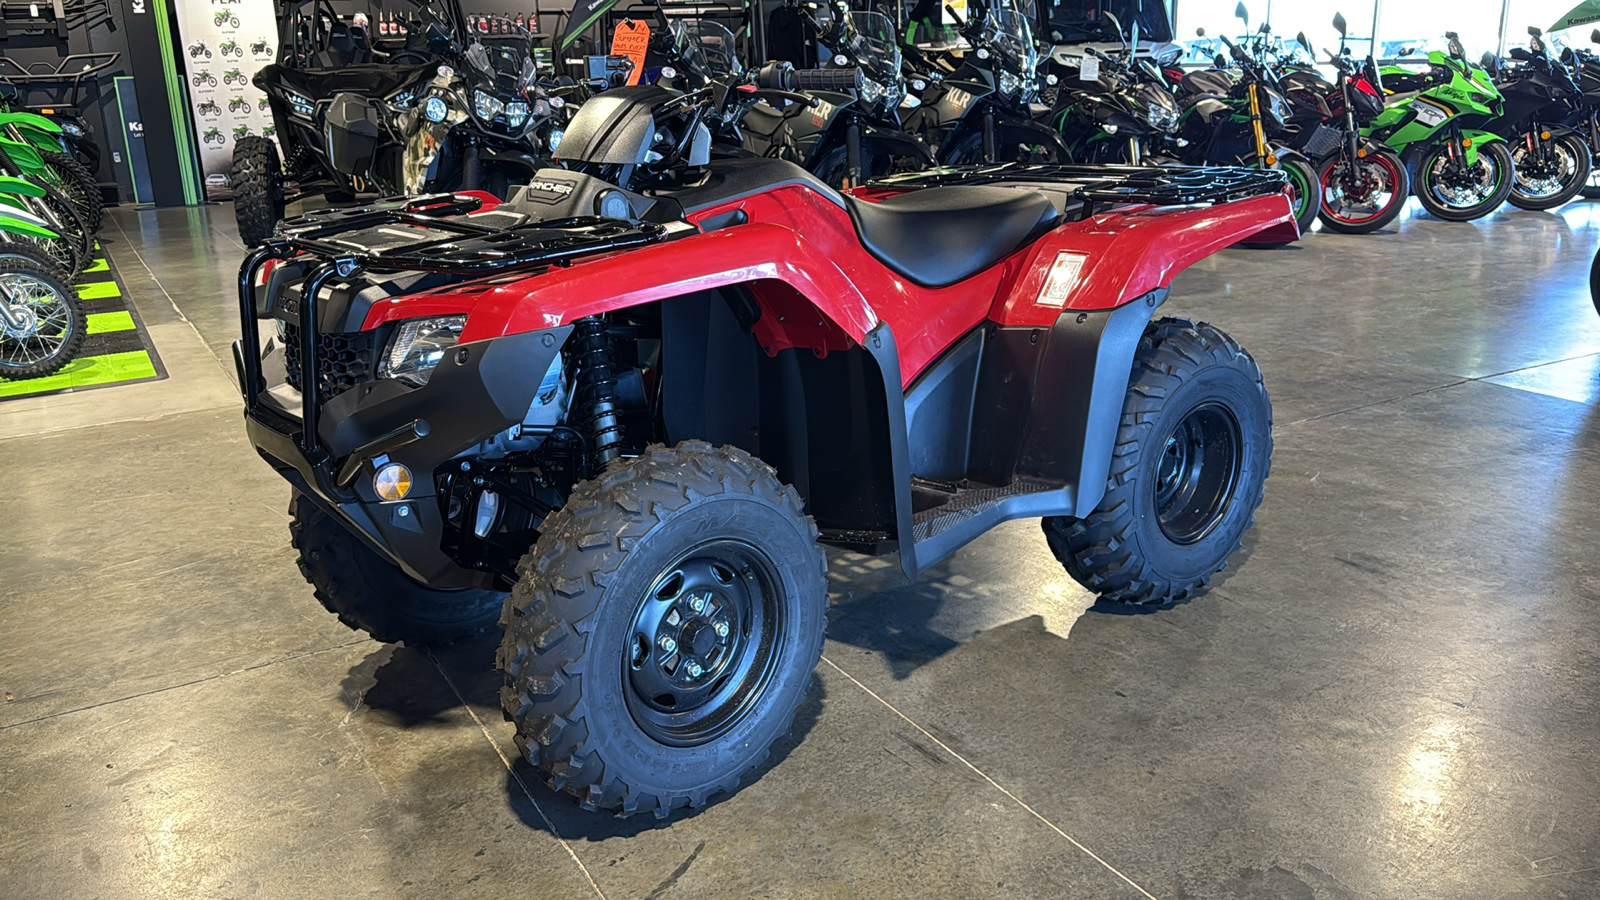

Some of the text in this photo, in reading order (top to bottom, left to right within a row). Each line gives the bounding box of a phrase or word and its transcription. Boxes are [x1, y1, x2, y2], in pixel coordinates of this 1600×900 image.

[616, 34, 646, 44] SUMMER
[945, 86, 971, 109] KLR
[528, 181, 574, 195] RANCHER
